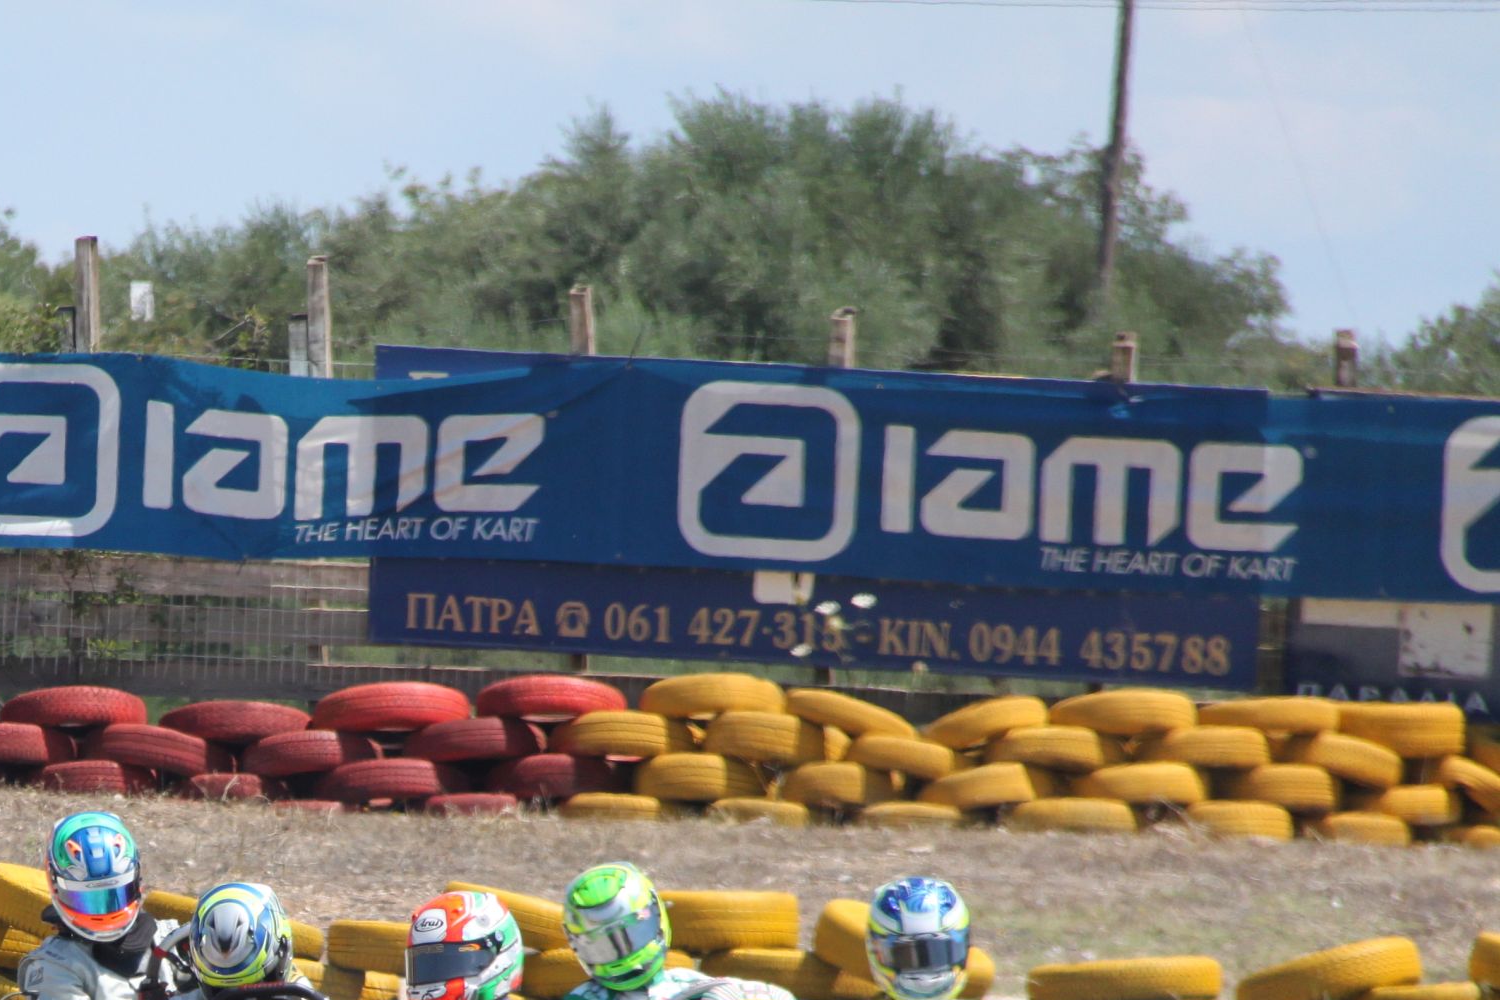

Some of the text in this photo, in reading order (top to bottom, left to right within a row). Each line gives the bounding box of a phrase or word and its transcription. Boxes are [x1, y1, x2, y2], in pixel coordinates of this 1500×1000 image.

[294, 516, 540, 543] THE HEART OF KART
[1040, 546, 1298, 582] THE HEART OF KART
[406, 592, 542, 637] ΠΑΤΡΑ
[604, 602, 673, 645] 061
[968, 620, 1062, 667] 0944
[1079, 629, 1232, 677] 435788
[415, 918, 443, 931] Arai
